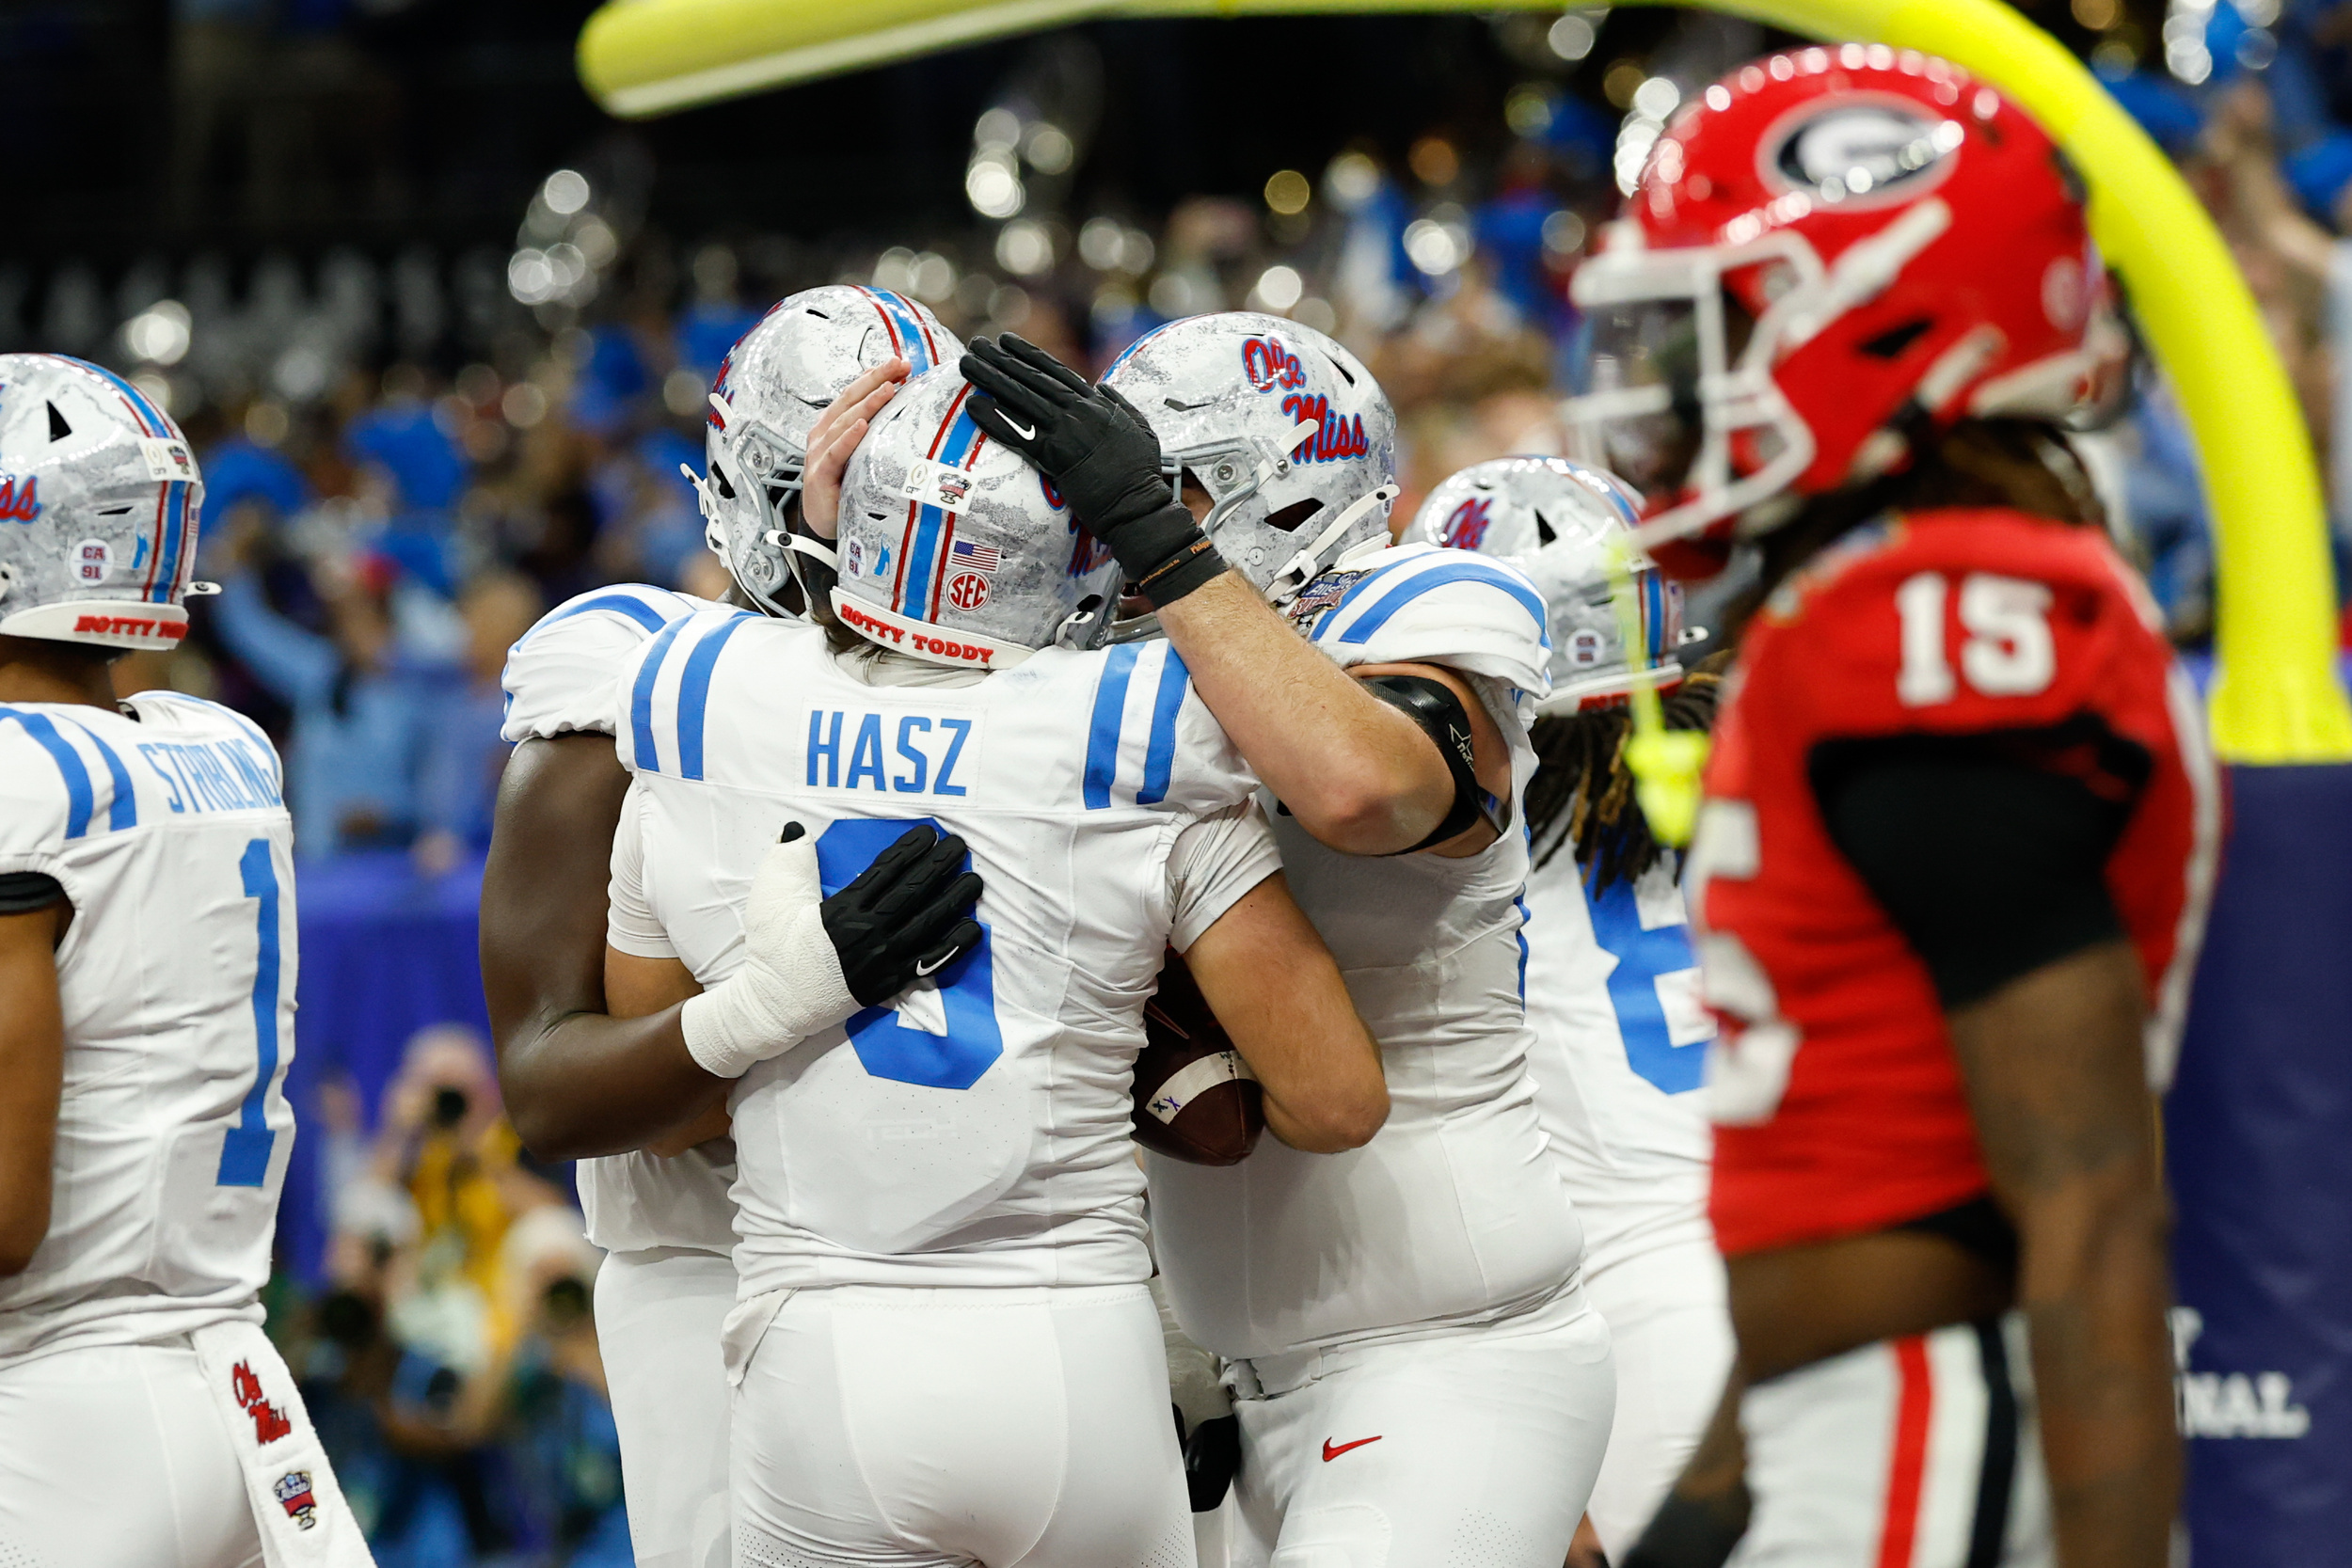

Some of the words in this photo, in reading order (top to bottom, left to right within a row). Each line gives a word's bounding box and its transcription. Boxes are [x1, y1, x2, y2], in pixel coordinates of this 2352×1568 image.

[1241, 337, 1307, 394] Ole
[1281, 393, 1370, 465] Miss
[0, 474, 42, 524] ss
[81, 545, 106, 561] CA
[82, 565, 103, 579] 91
[950, 575, 987, 609] SEC
[74, 615, 157, 637] HOTTY
[840, 603, 905, 643] HOTTY
[912, 634, 994, 663] TODDY
[1896, 569, 2058, 707] 15
[805, 709, 973, 798] HASZ
[215, 838, 276, 1187] 1
[2173, 1370, 2312, 1440] NAL
